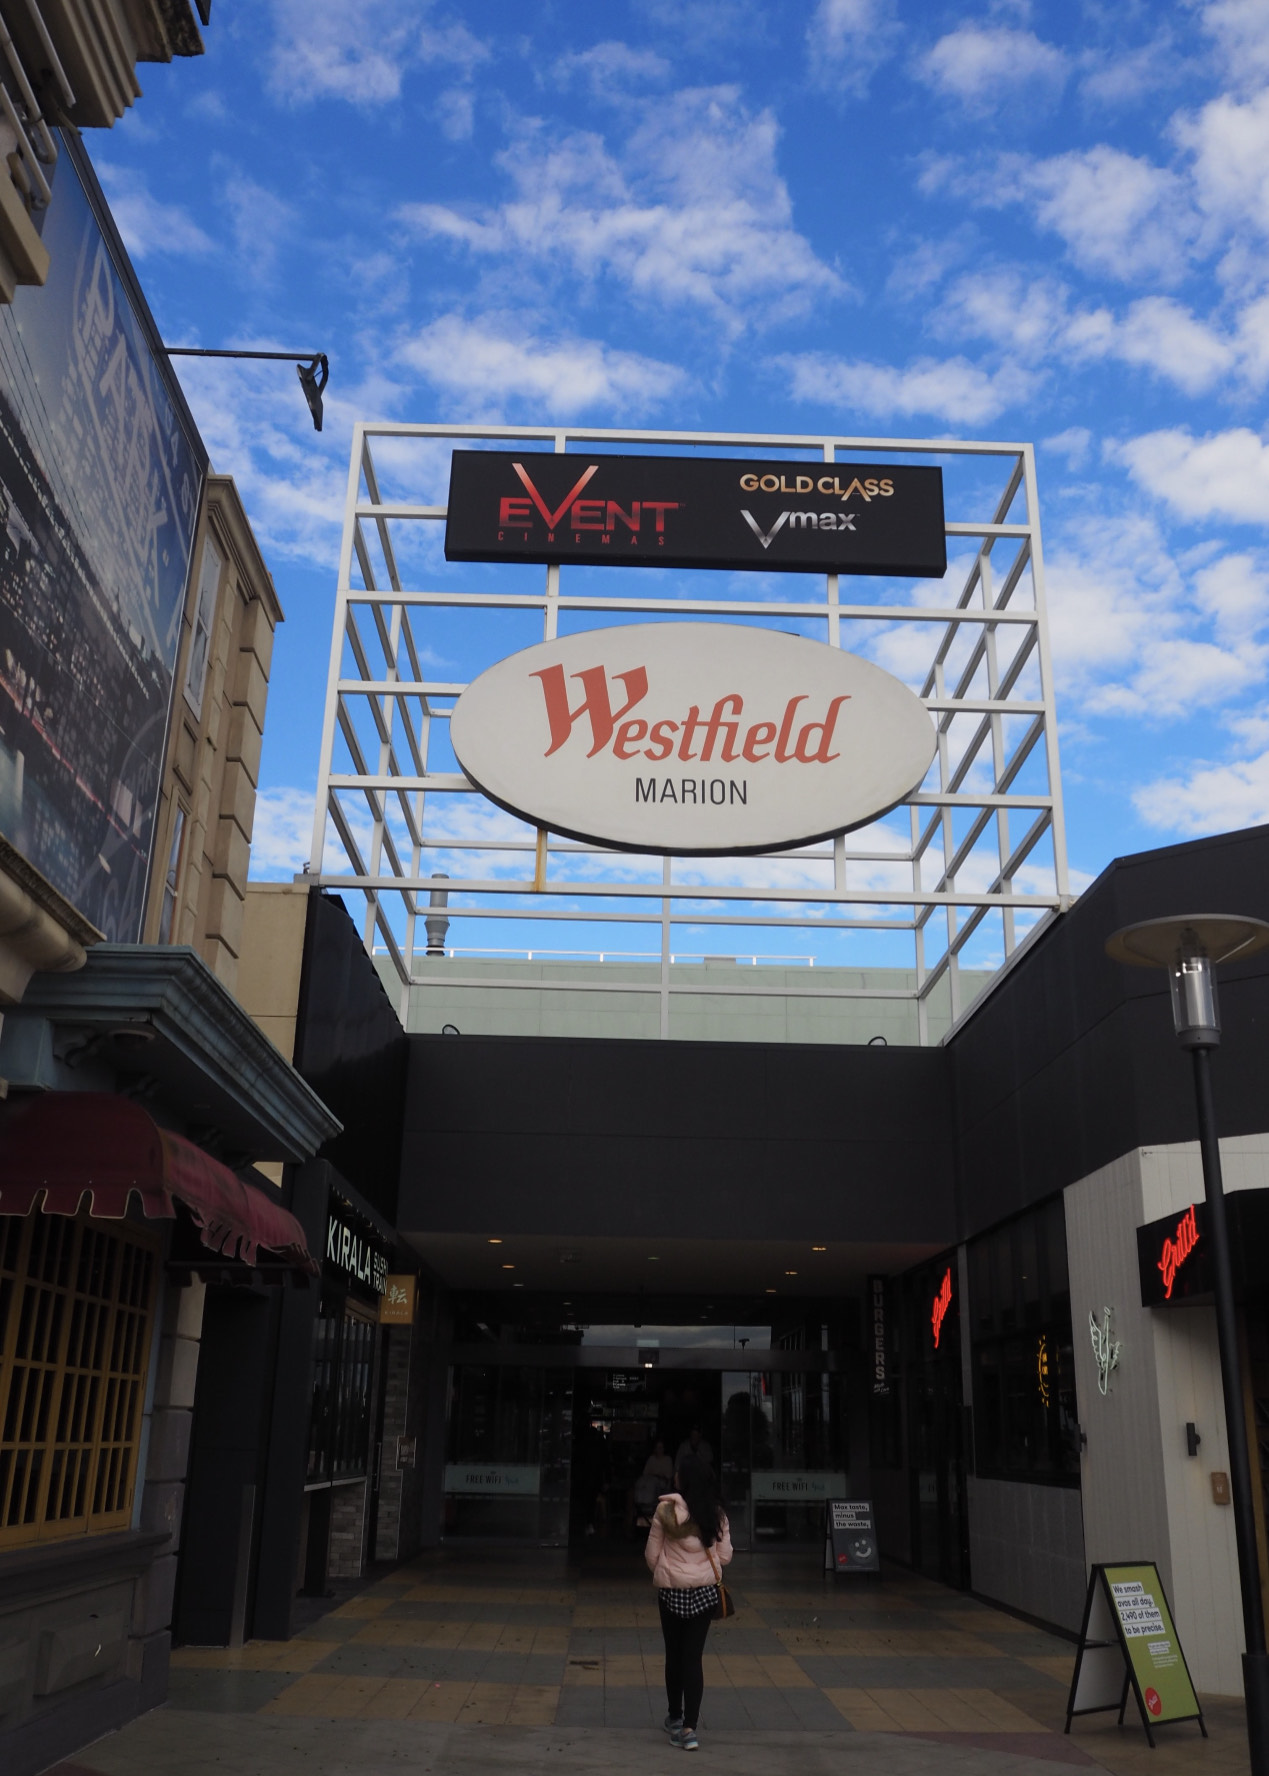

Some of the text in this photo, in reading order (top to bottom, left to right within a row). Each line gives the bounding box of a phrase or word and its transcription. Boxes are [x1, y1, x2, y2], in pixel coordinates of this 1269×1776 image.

[499, 462, 680, 532] EVENT
[740, 474, 895, 501] GOLD CLASS
[497, 532, 665, 545] CINEMAS
[740, 509, 857, 549] Vmax
[528, 663, 852, 764] Westfield
[635, 777, 748, 805] MARION
[326, 1215, 371, 1285] KIRALA
[373, 1251, 389, 1276] SUSHI
[373, 1271, 388, 1296] TRAIN
[388, 1284, 408, 1304] 転
[873, 1279, 886, 1380] BURGERS
[465, 1474, 483, 1484] FREE
[772, 1481, 790, 1491] FREE
[1112, 1583, 1142, 1594] We smash
[1117, 1600, 1130, 1608] avos
[1131, 1598, 1139, 1606] all
[1120, 1608, 1160, 1622] 2,490 of them
[1124, 1622, 1164, 1635] to be precise.
